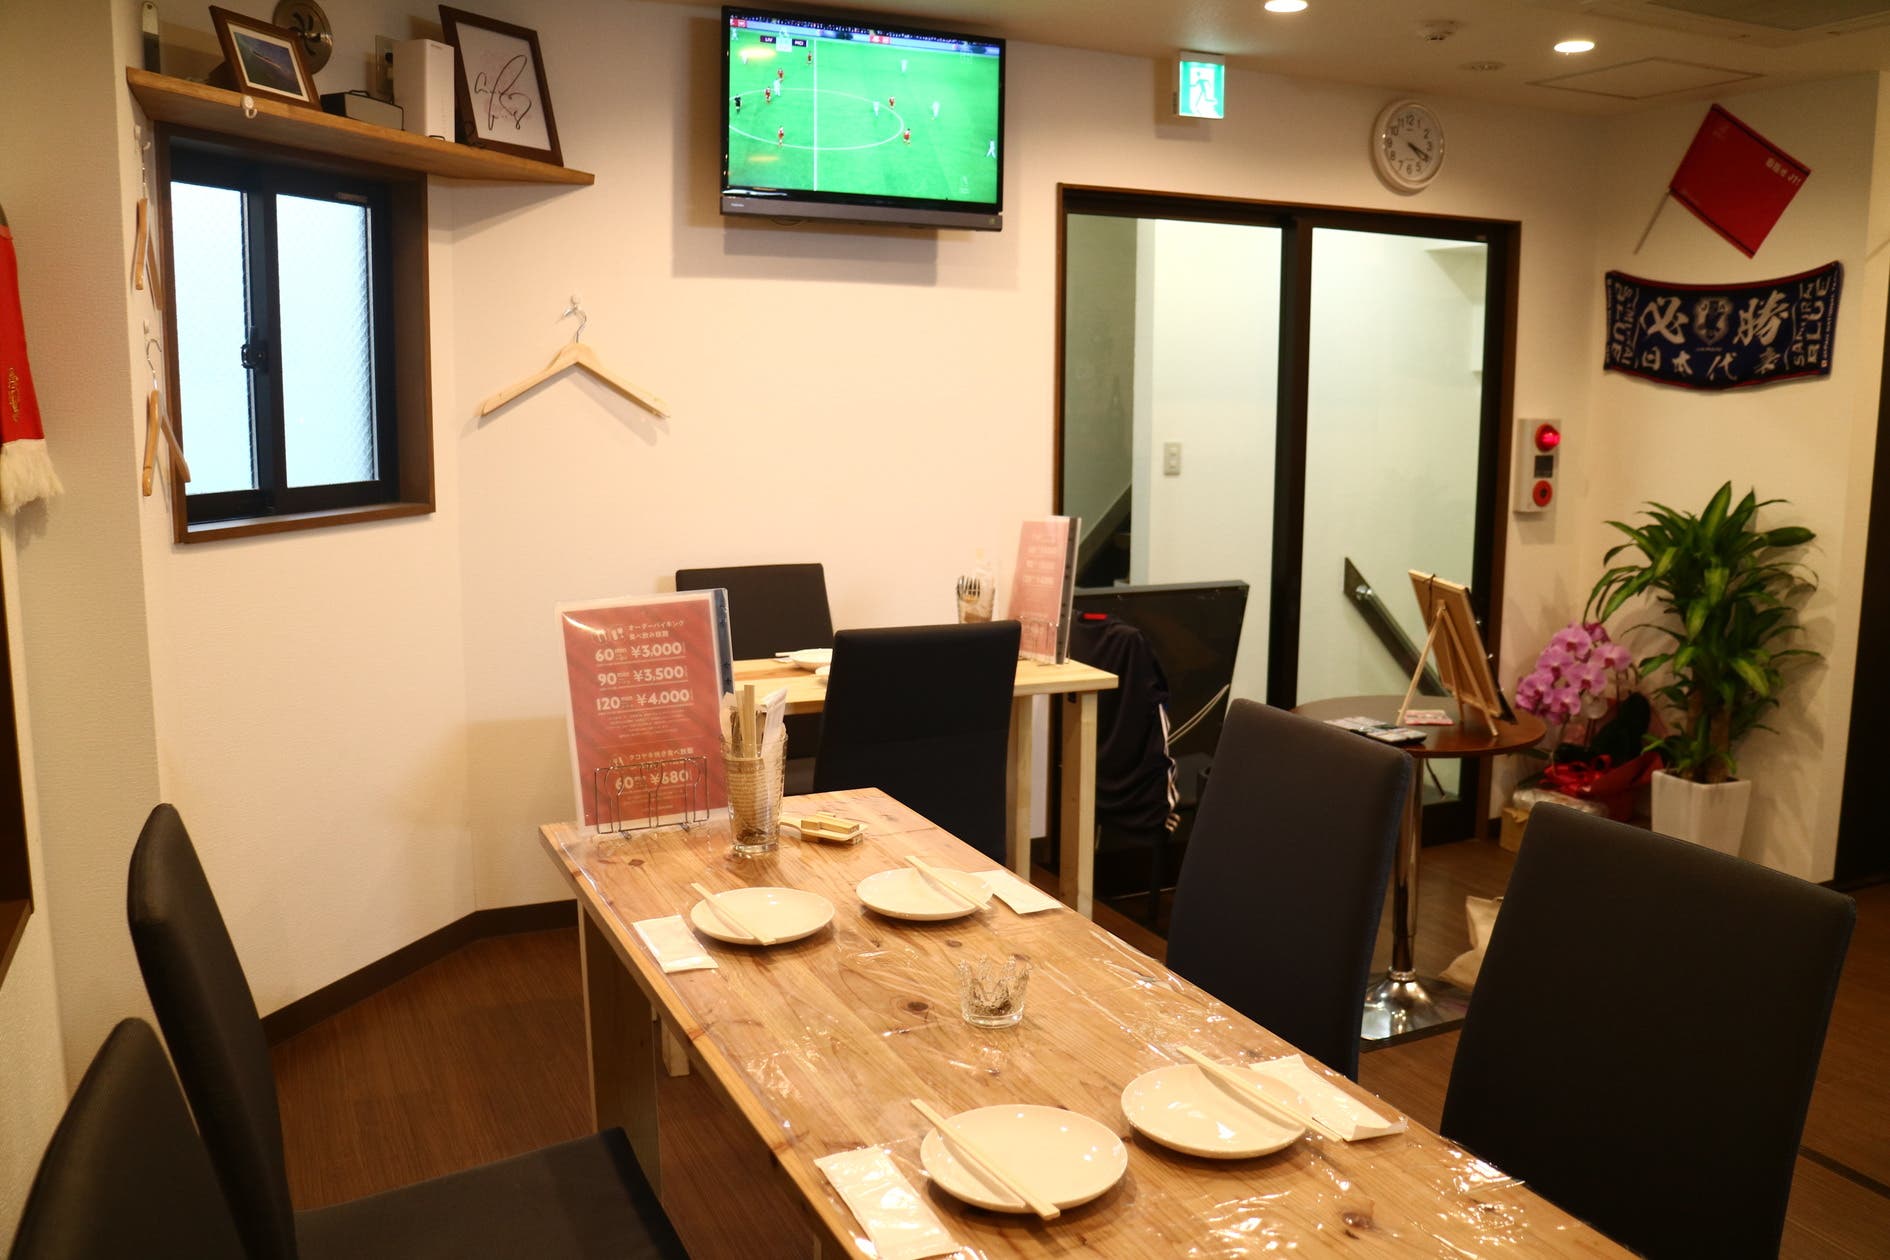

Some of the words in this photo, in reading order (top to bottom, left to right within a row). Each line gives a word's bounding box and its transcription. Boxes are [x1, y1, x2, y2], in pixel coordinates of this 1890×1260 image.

[1398, 118, 1405, 127] 11
[1406, 114, 1415, 126] 12
[1418, 120, 1421, 128] 1
[1391, 125, 1399, 136] 10
[1424, 129, 1429, 139] 2
[1386, 138, 1392, 148] 9
[1426, 142, 1432, 151] 3
[1390, 151, 1396, 160] 8
[1398, 160, 1403, 170] 7
[1406, 164, 1412, 175] 6
[1416, 162, 1421, 171] 5
[595, 648, 614, 662] 60
[631, 642, 682, 658] ¥3,000
[598, 672, 617, 686] 90
[633, 666, 684, 681] ¥3,500
[596, 696, 620, 711] 120
[636, 689, 689, 706] ¥4,000
[615, 776, 634, 790] 60
[650, 769, 689, 785] ¥680
